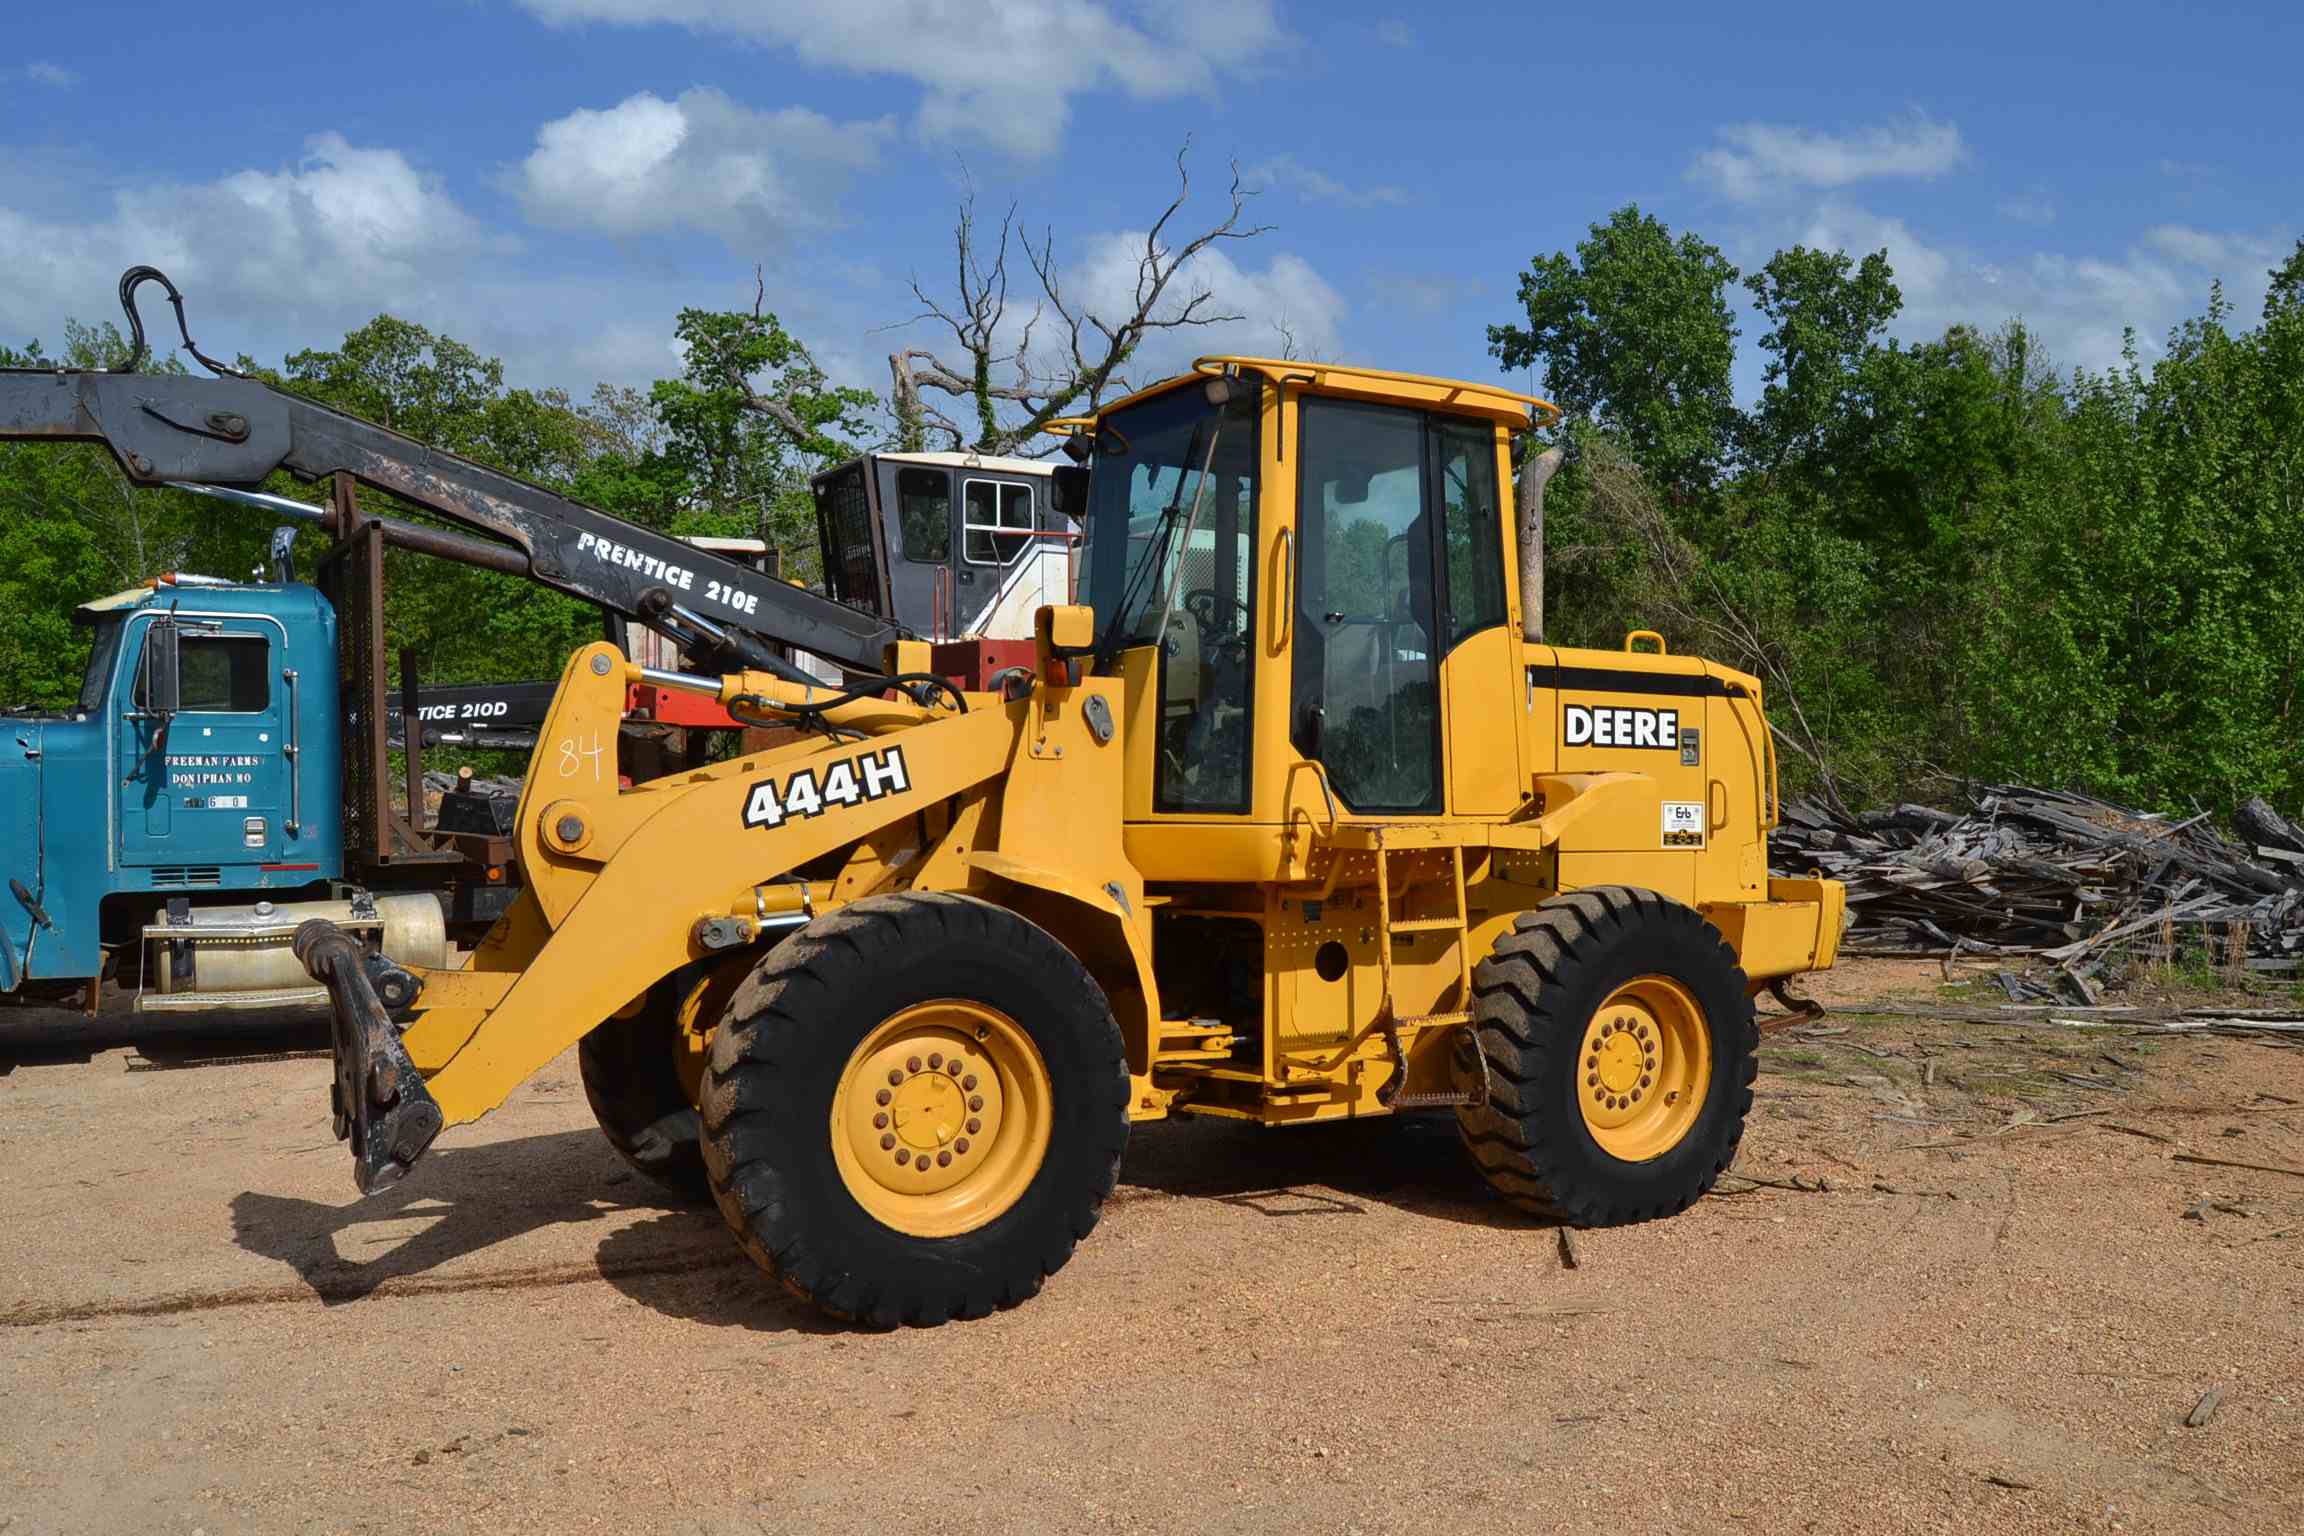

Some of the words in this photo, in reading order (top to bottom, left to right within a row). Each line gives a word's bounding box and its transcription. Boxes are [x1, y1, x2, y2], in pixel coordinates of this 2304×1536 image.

[577, 532, 694, 591] PRENTICE
[704, 580, 759, 615] 210E
[461, 702, 507, 718] 210D
[1565, 705, 1678, 749] DEERE
[164, 756, 218, 767] FREEMAN
[223, 756, 258, 767] FARMS
[559, 729, 604, 782] 84
[172, 773, 232, 784] DONIPHAN
[236, 773, 252, 784] MO
[742, 746, 910, 830] 444H
